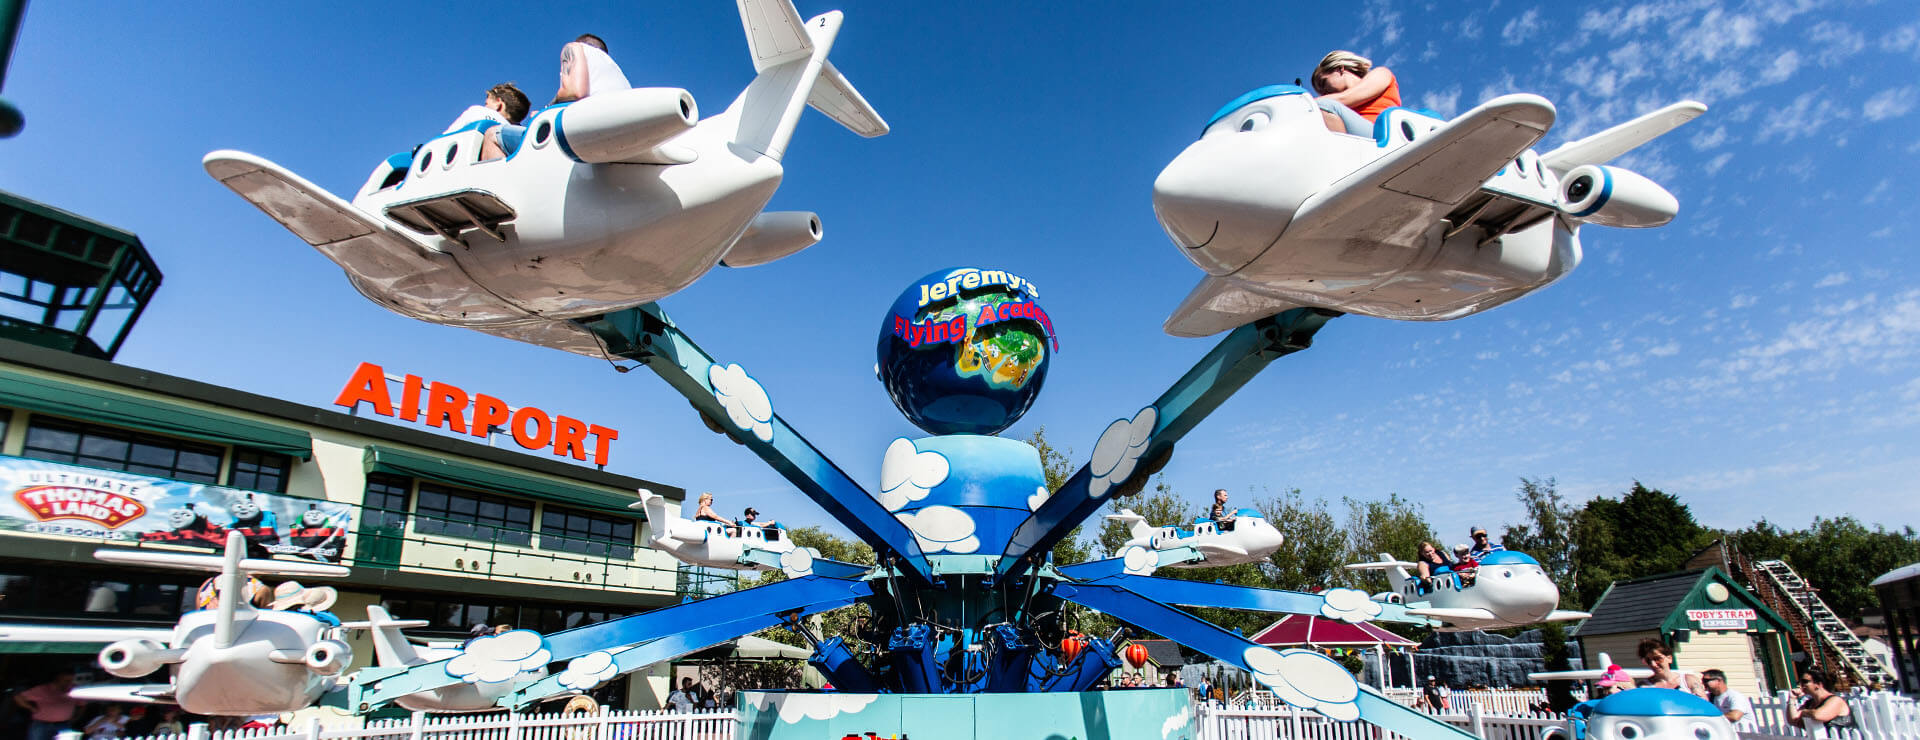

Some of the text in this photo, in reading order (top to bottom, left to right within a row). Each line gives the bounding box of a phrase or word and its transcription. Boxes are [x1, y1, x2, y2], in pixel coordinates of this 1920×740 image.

[819, 17, 826, 27] 2
[918, 270, 1040, 307] Jeremy's
[895, 300, 1059, 353] Flying Academ
[333, 361, 619, 466] AIRPORT
[30, 473, 140, 496] ULTIMATE
[24, 488, 139, 517] THOMAS
[52, 502, 111, 520] LAND
[1688, 610, 1754, 619] TOBY'S TRAM
